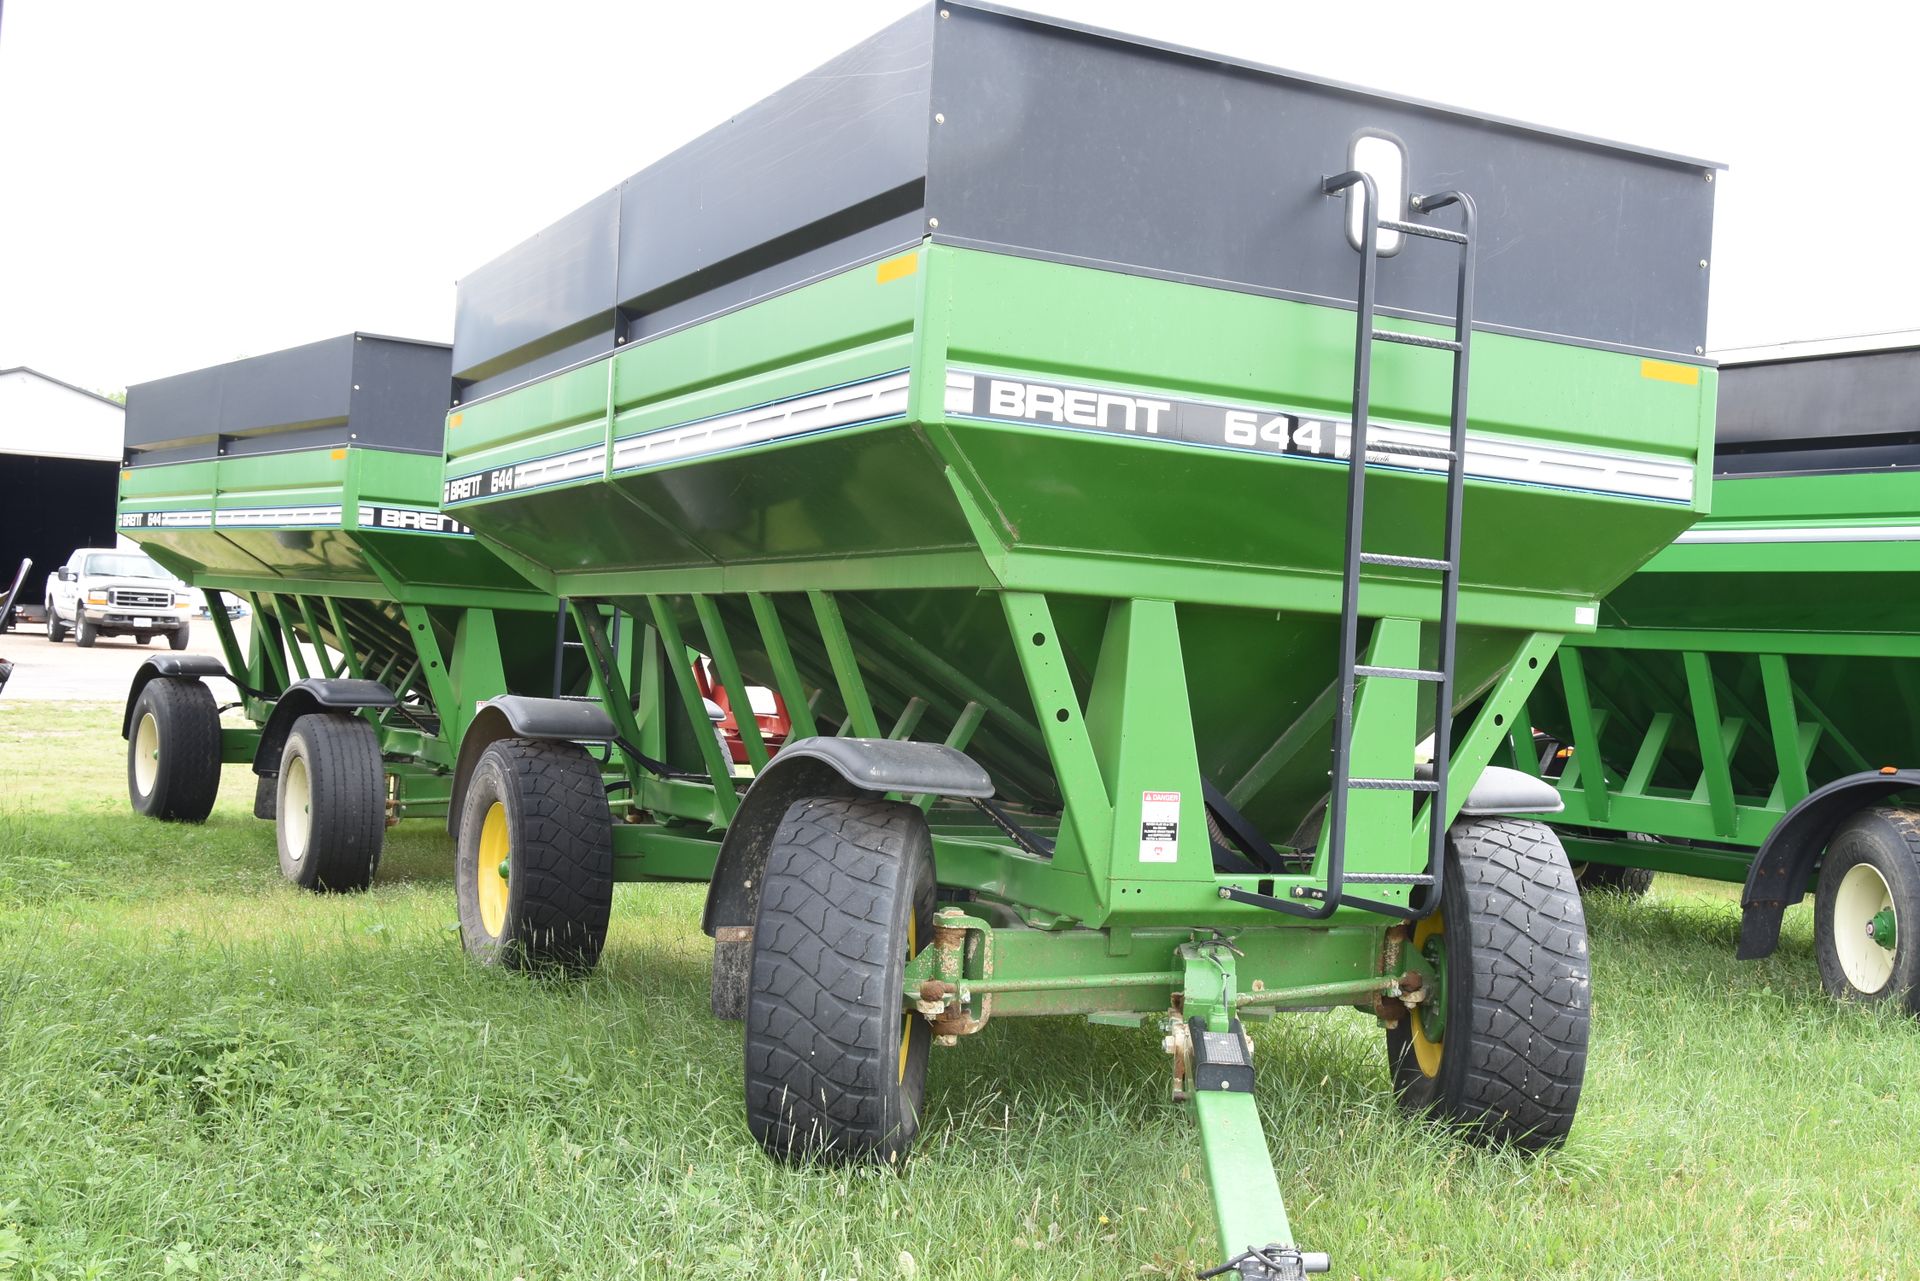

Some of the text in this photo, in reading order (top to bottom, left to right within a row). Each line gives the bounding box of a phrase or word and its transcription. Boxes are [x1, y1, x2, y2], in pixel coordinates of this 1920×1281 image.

[989, 380, 1322, 454] BRENT 644
[450, 468, 513, 501] BRENT 644
[147, 513, 161, 526] 644
